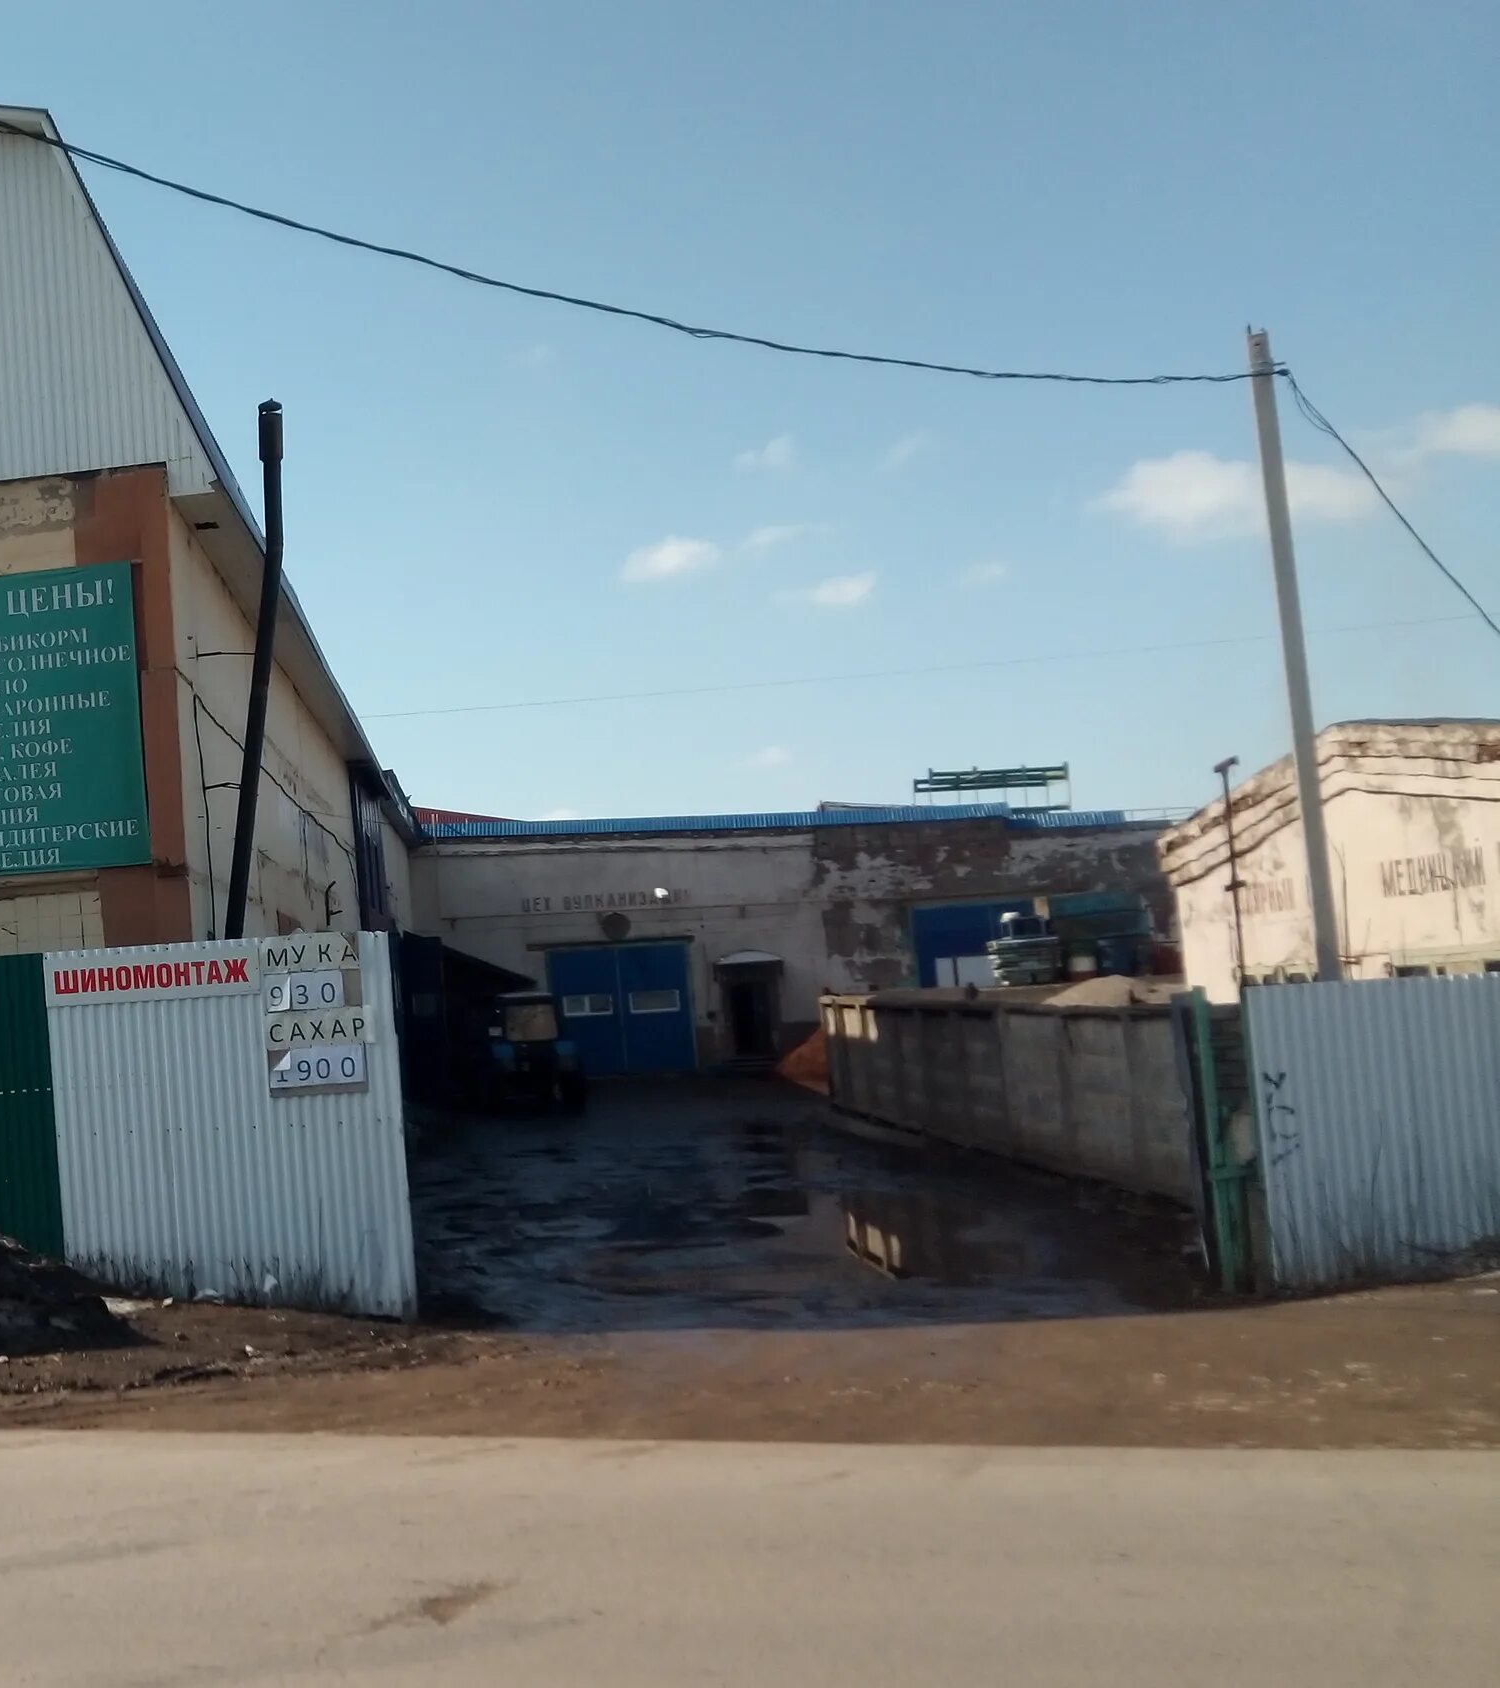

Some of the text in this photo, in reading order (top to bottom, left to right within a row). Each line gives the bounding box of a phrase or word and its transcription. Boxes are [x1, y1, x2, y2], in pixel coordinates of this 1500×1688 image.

[6, 578, 115, 618] ЦЕНЫ!
[11, 738, 73, 759] КОФЕ
[267, 943, 359, 967] МУКА
[53, 958, 250, 994] ШИНОМОНТАЖ
[270, 983, 335, 1006] 930
[269, 1018, 365, 1042] САХАР
